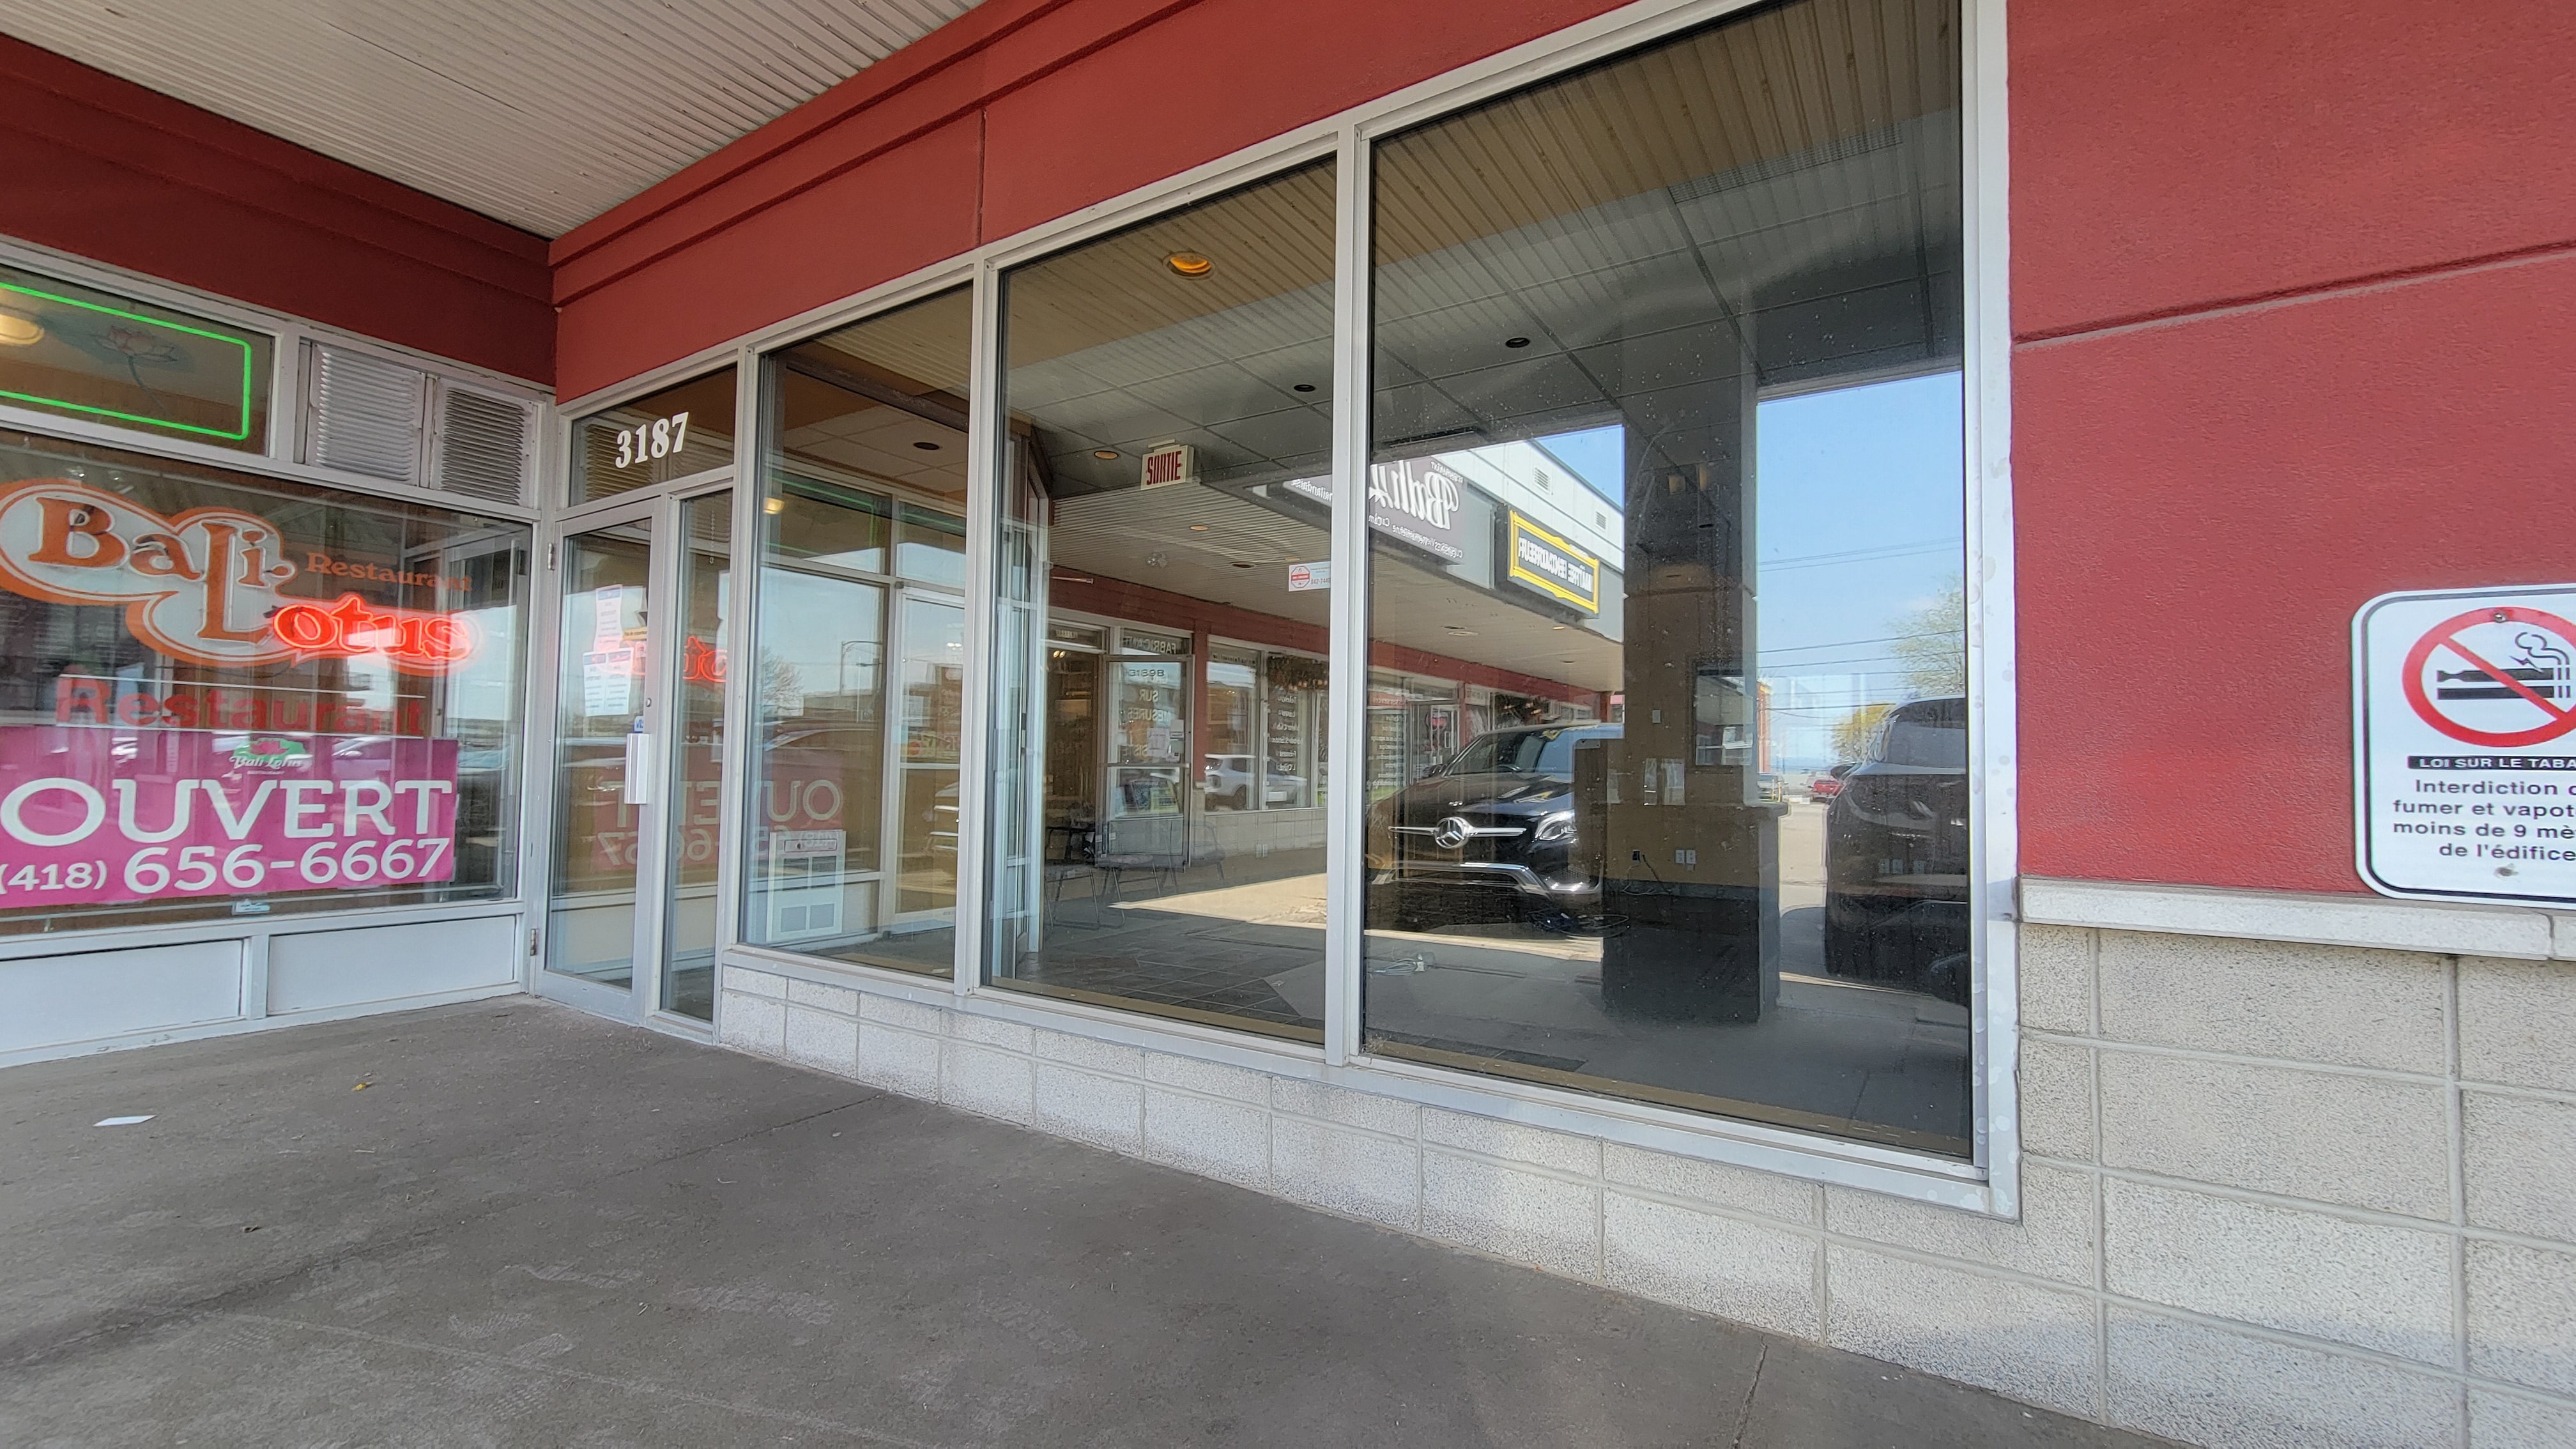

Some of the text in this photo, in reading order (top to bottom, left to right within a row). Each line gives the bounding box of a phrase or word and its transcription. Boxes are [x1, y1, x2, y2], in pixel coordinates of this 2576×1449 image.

[615, 411, 689, 469] 3187
[1146, 450, 1183, 486] SORTIE
[305, 552, 473, 592] Restaurant
[55, 674, 426, 736] Restaurant
[229, 755, 303, 770] Bali Lotus
[2419, 758, 2576, 769] LOI SUR LE TABA
[2416, 779, 2558, 795] Interdiction
[1, 778, 452, 847] OUVERT
[2393, 799, 2576, 820] fumer et vapot
[2393, 821, 2576, 839] moins de 9 mè
[0, 838, 450, 894] (418) 656-6667
[2439, 843, 2576, 861] de l'édifice
